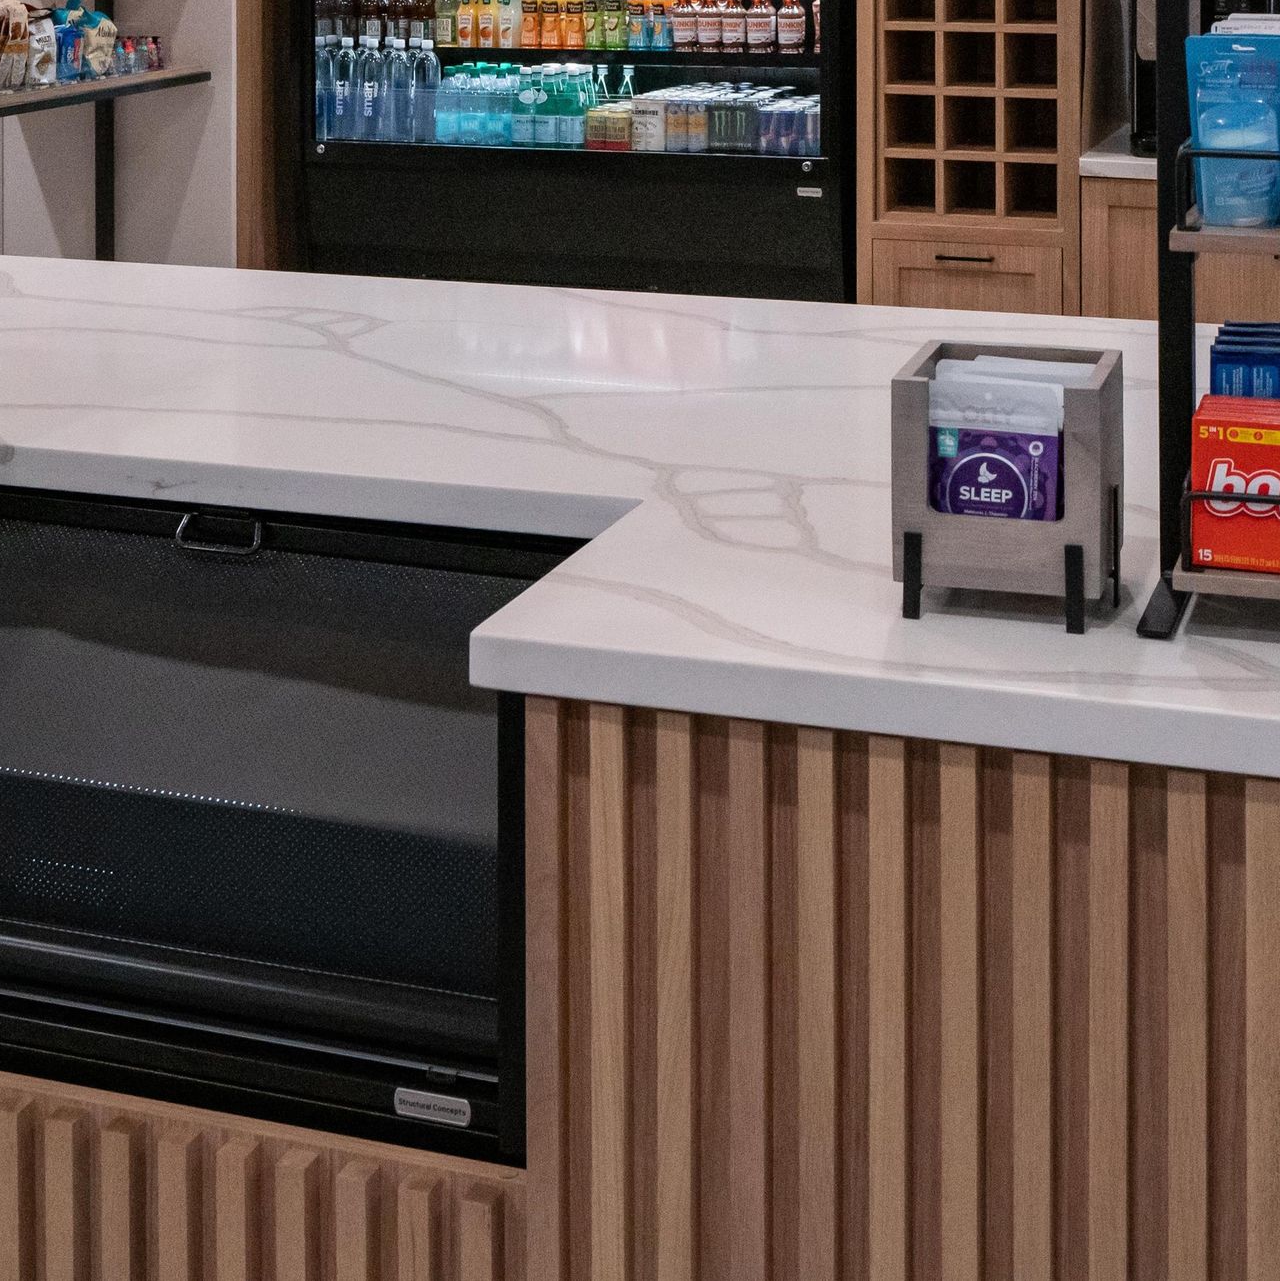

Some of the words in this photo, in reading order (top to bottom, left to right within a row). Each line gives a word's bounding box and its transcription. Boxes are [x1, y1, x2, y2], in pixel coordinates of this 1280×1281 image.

[1197, 59, 1234, 77] Secret
[335, 80, 345, 115] smart
[363, 80, 373, 117] smart
[1199, 425, 1209, 439] 5
[1209, 425, 1217, 433] IN
[1217, 427, 1225, 440] 1
[959, 485, 1013, 504] SLEEP
[1198, 548, 1213, 562] 15
[398, 1098, 431, 1111] Structural
[432, 1103, 467, 1116] Concepts
